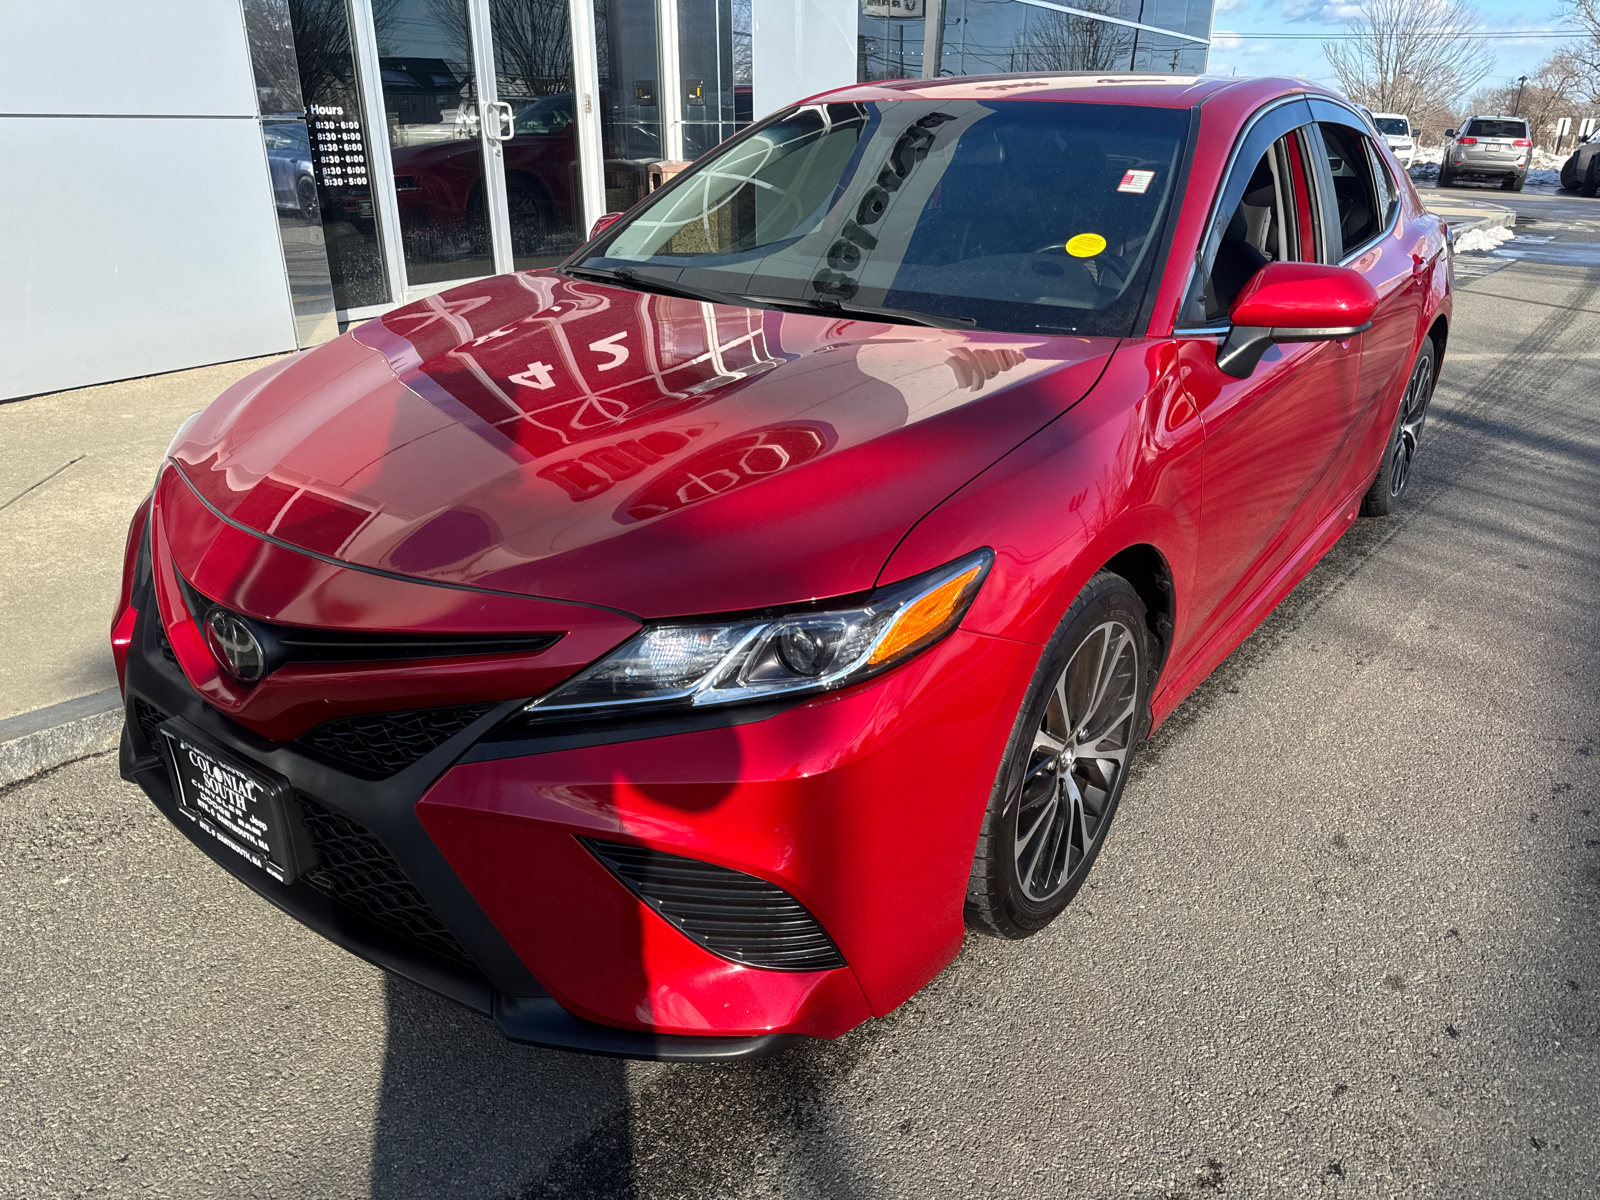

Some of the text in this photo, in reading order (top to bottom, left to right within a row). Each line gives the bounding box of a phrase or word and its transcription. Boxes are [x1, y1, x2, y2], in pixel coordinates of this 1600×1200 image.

[310, 104, 344, 115] Hours
[188, 750, 257, 803] COLONIAL
[202, 772, 247, 812] SOUTH
[191, 778, 243, 818] CHRYSLER
[200, 791, 232, 819] DODGE
